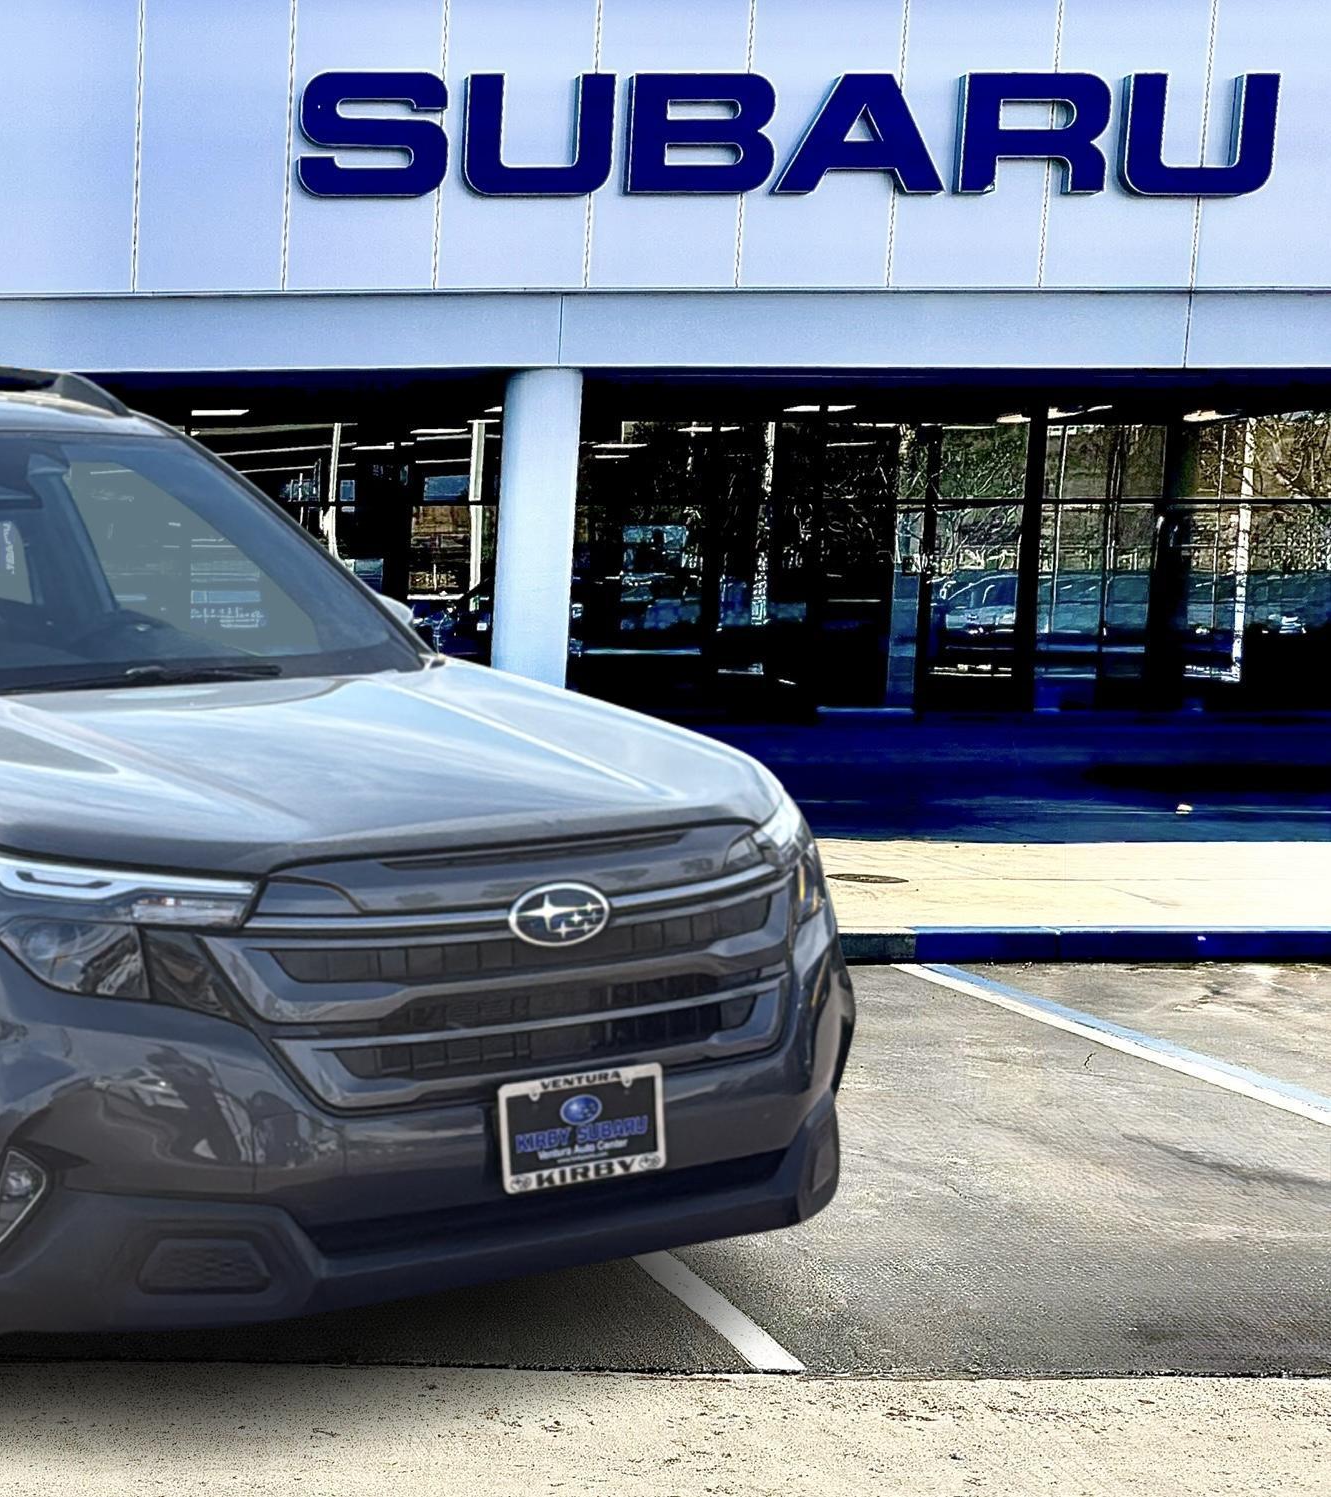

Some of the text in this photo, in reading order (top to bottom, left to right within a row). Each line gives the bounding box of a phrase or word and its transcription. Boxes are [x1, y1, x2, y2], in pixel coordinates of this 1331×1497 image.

[296, 70, 1282, 198] SUBARU
[540, 1070, 623, 1091] VENTURA
[515, 1114, 649, 1154] KIRBY SUBARU
[574, 1142, 596, 1154] Auto
[596, 1139, 629, 1151] Center
[535, 1157, 637, 1188] KIRBY
